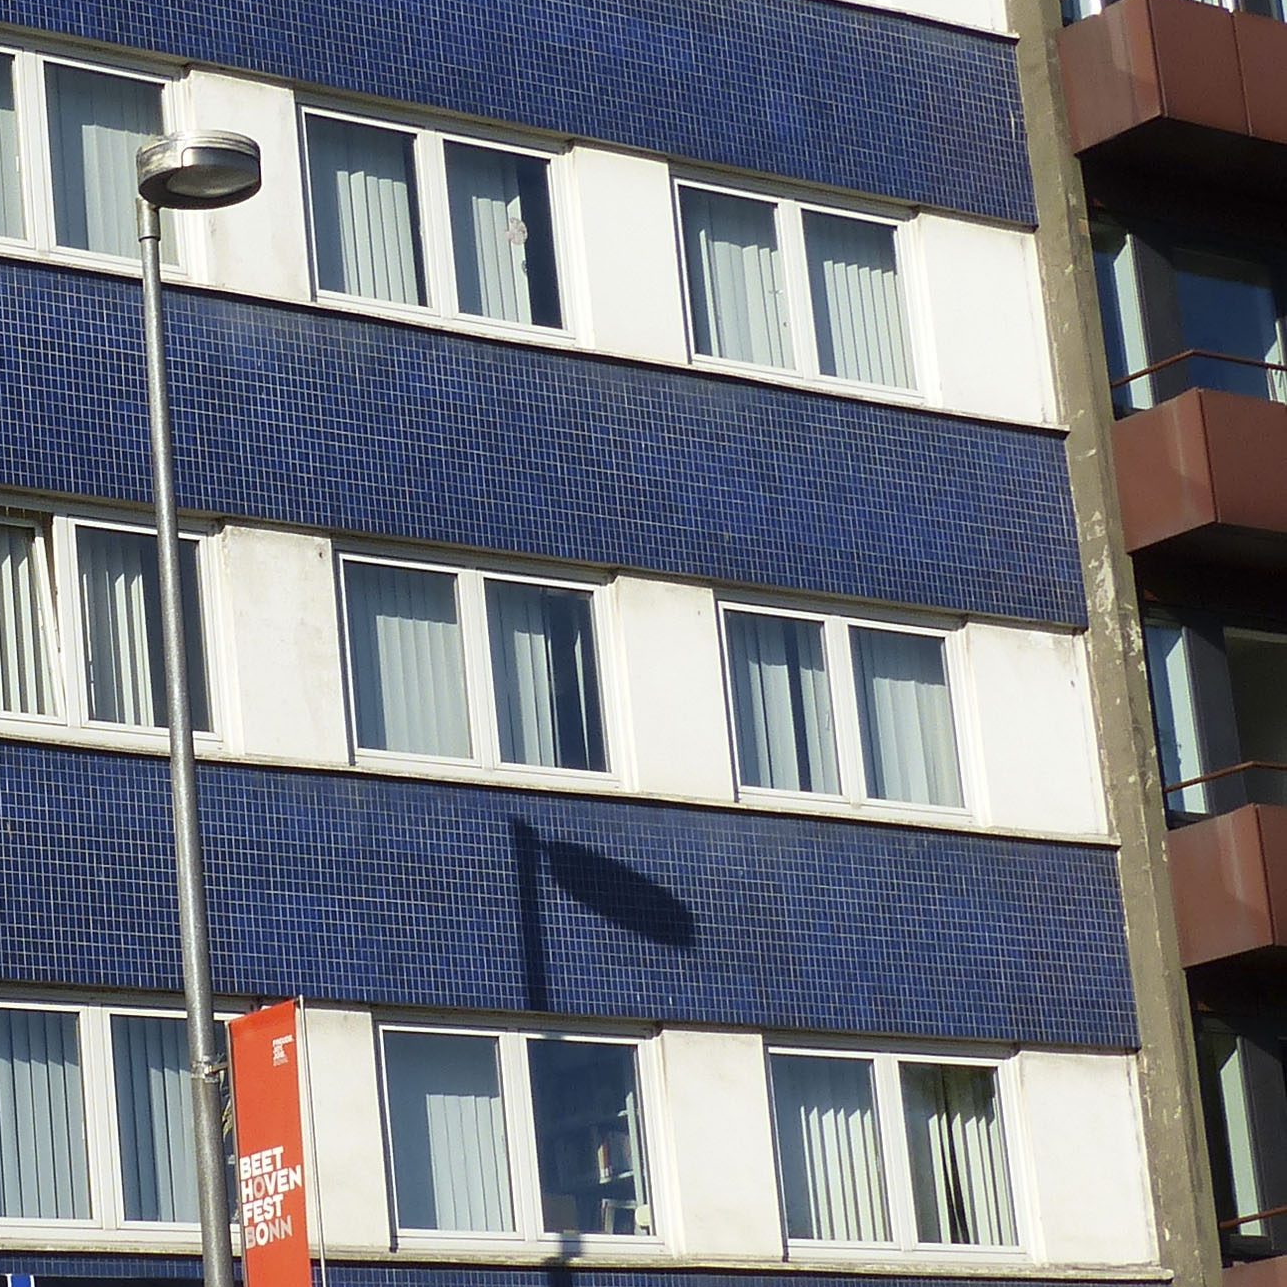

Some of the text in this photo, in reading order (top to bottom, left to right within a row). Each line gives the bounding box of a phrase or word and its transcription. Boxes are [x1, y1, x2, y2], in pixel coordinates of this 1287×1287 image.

[240, 1146, 284, 1180] BEET
[241, 1165, 303, 1203] HOVEN
[243, 1194, 284, 1226] FEST
[245, 1215, 293, 1249] BONN
